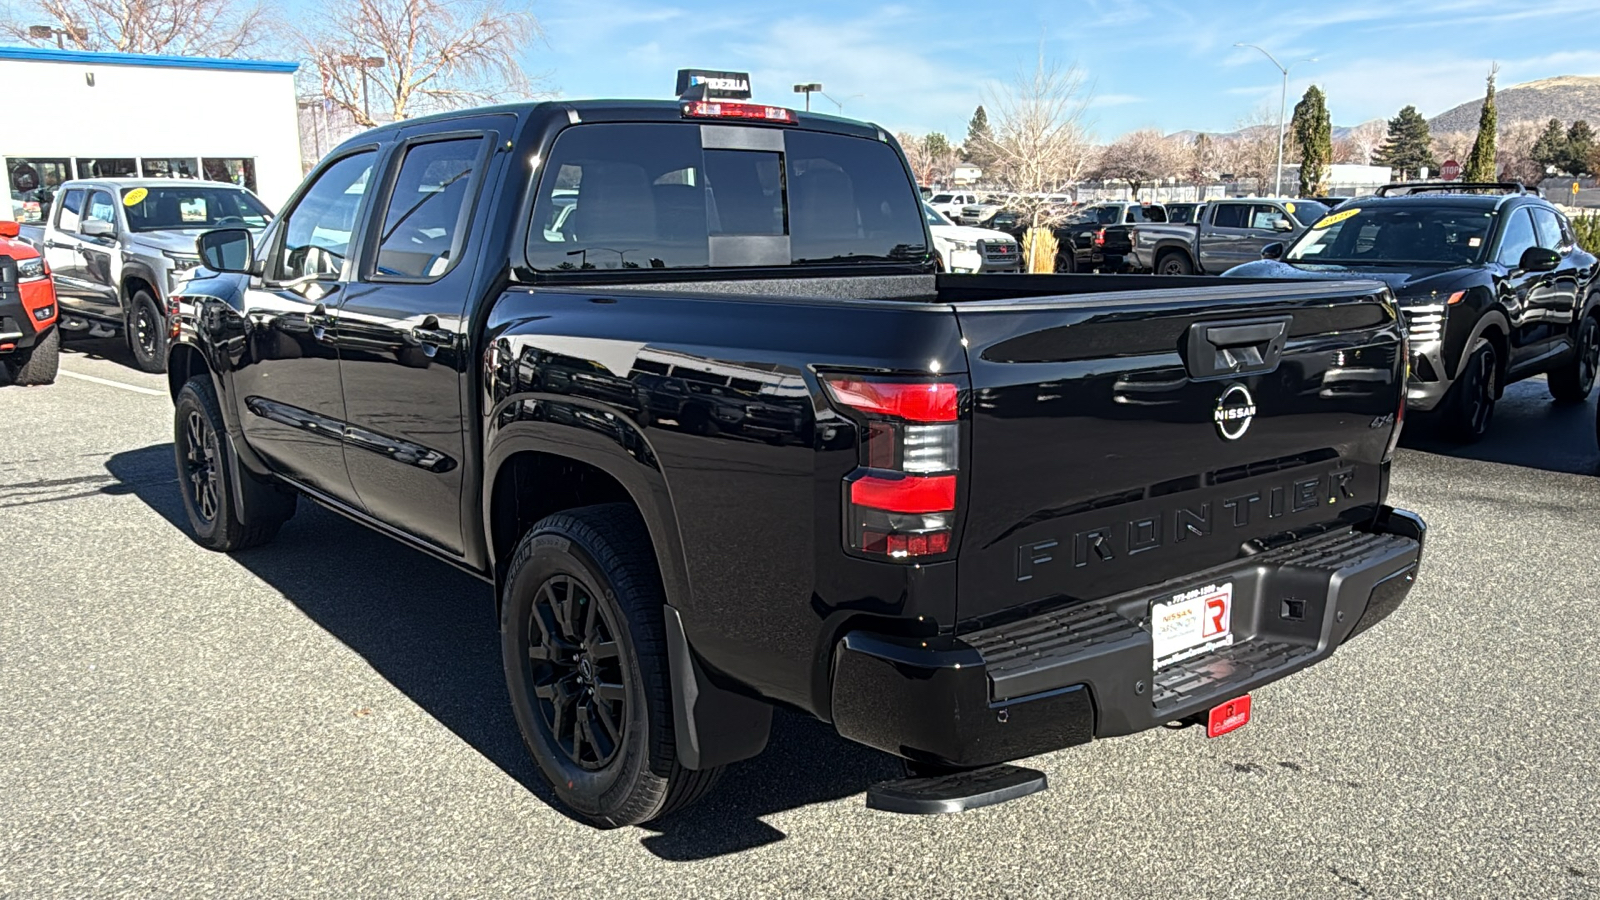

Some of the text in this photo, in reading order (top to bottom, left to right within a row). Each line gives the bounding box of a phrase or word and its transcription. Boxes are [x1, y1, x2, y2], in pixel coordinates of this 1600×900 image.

[1441, 165, 1459, 175] STOP
[1214, 405, 1256, 421] NISSAN
[1016, 464, 1356, 582] FRONTIER
[1162, 609, 1193, 623] NISSAN
